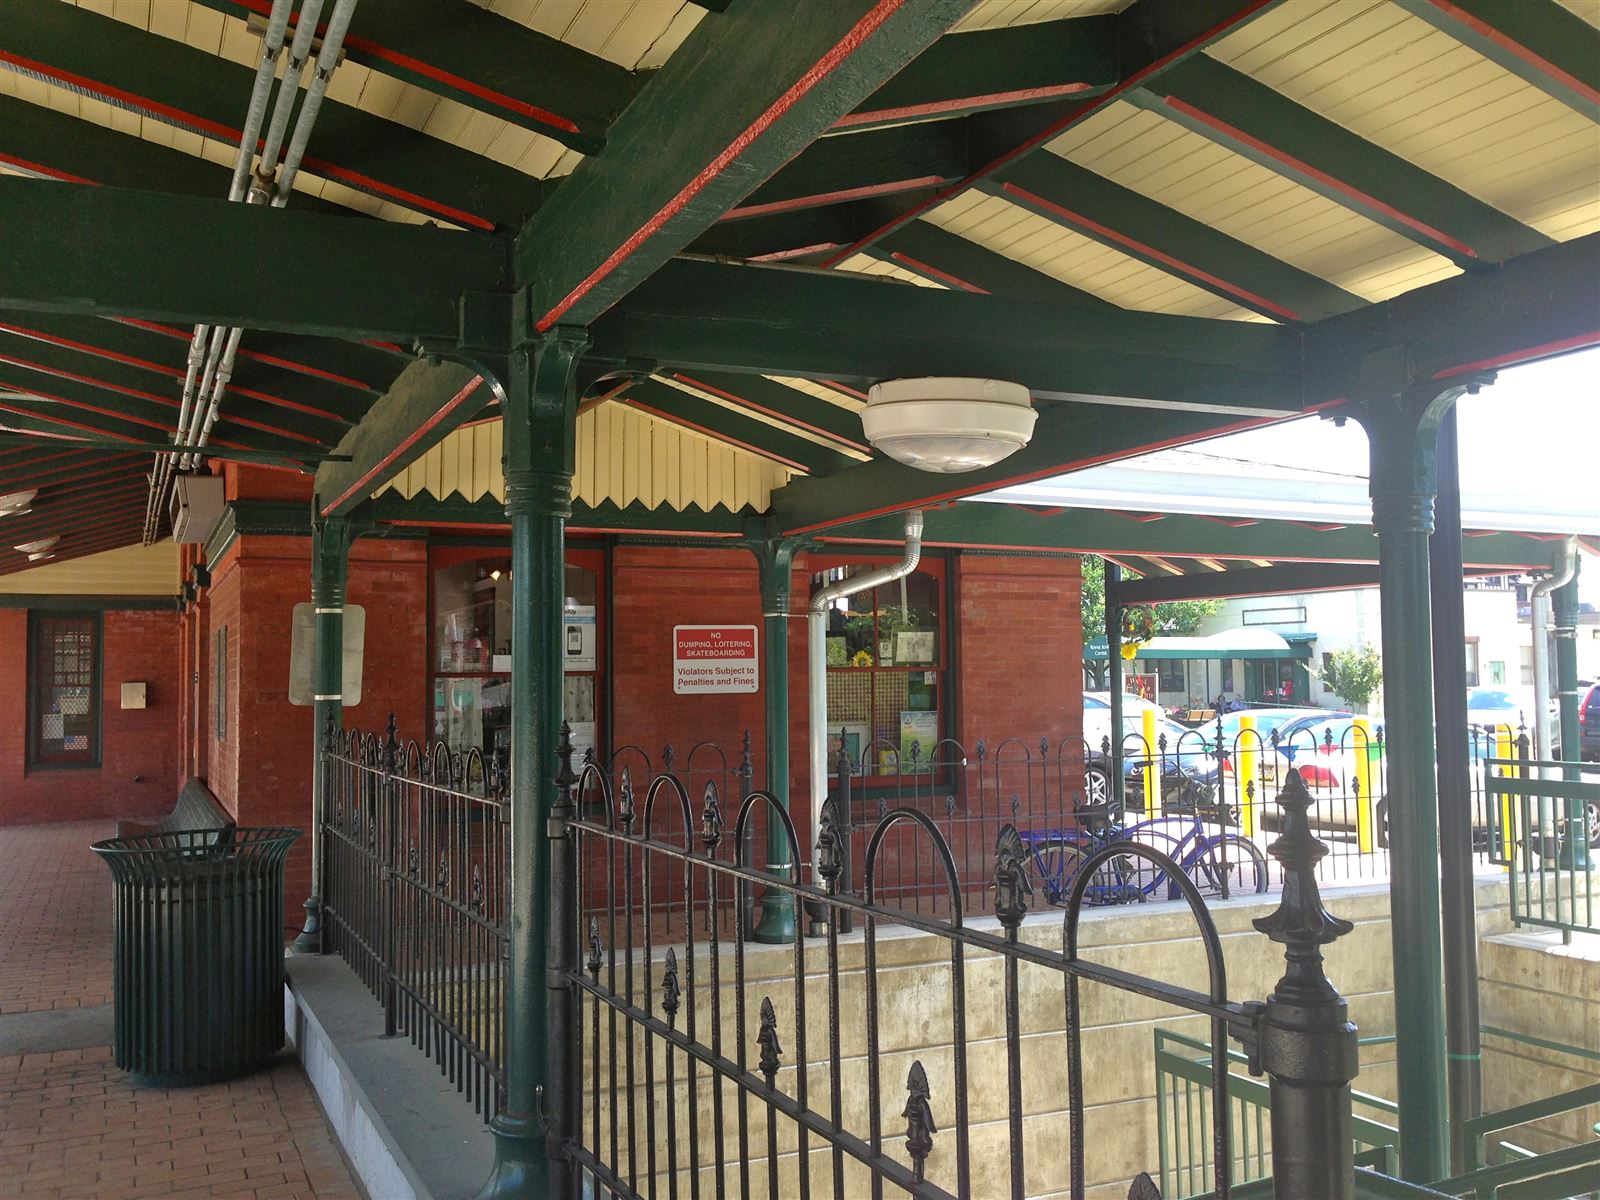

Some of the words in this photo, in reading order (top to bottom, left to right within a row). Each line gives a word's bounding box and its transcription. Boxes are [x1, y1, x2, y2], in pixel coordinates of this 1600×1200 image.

[715, 667, 744, 676] Subject
[678, 678, 714, 686] Penalties
[733, 677, 754, 685] Fines
